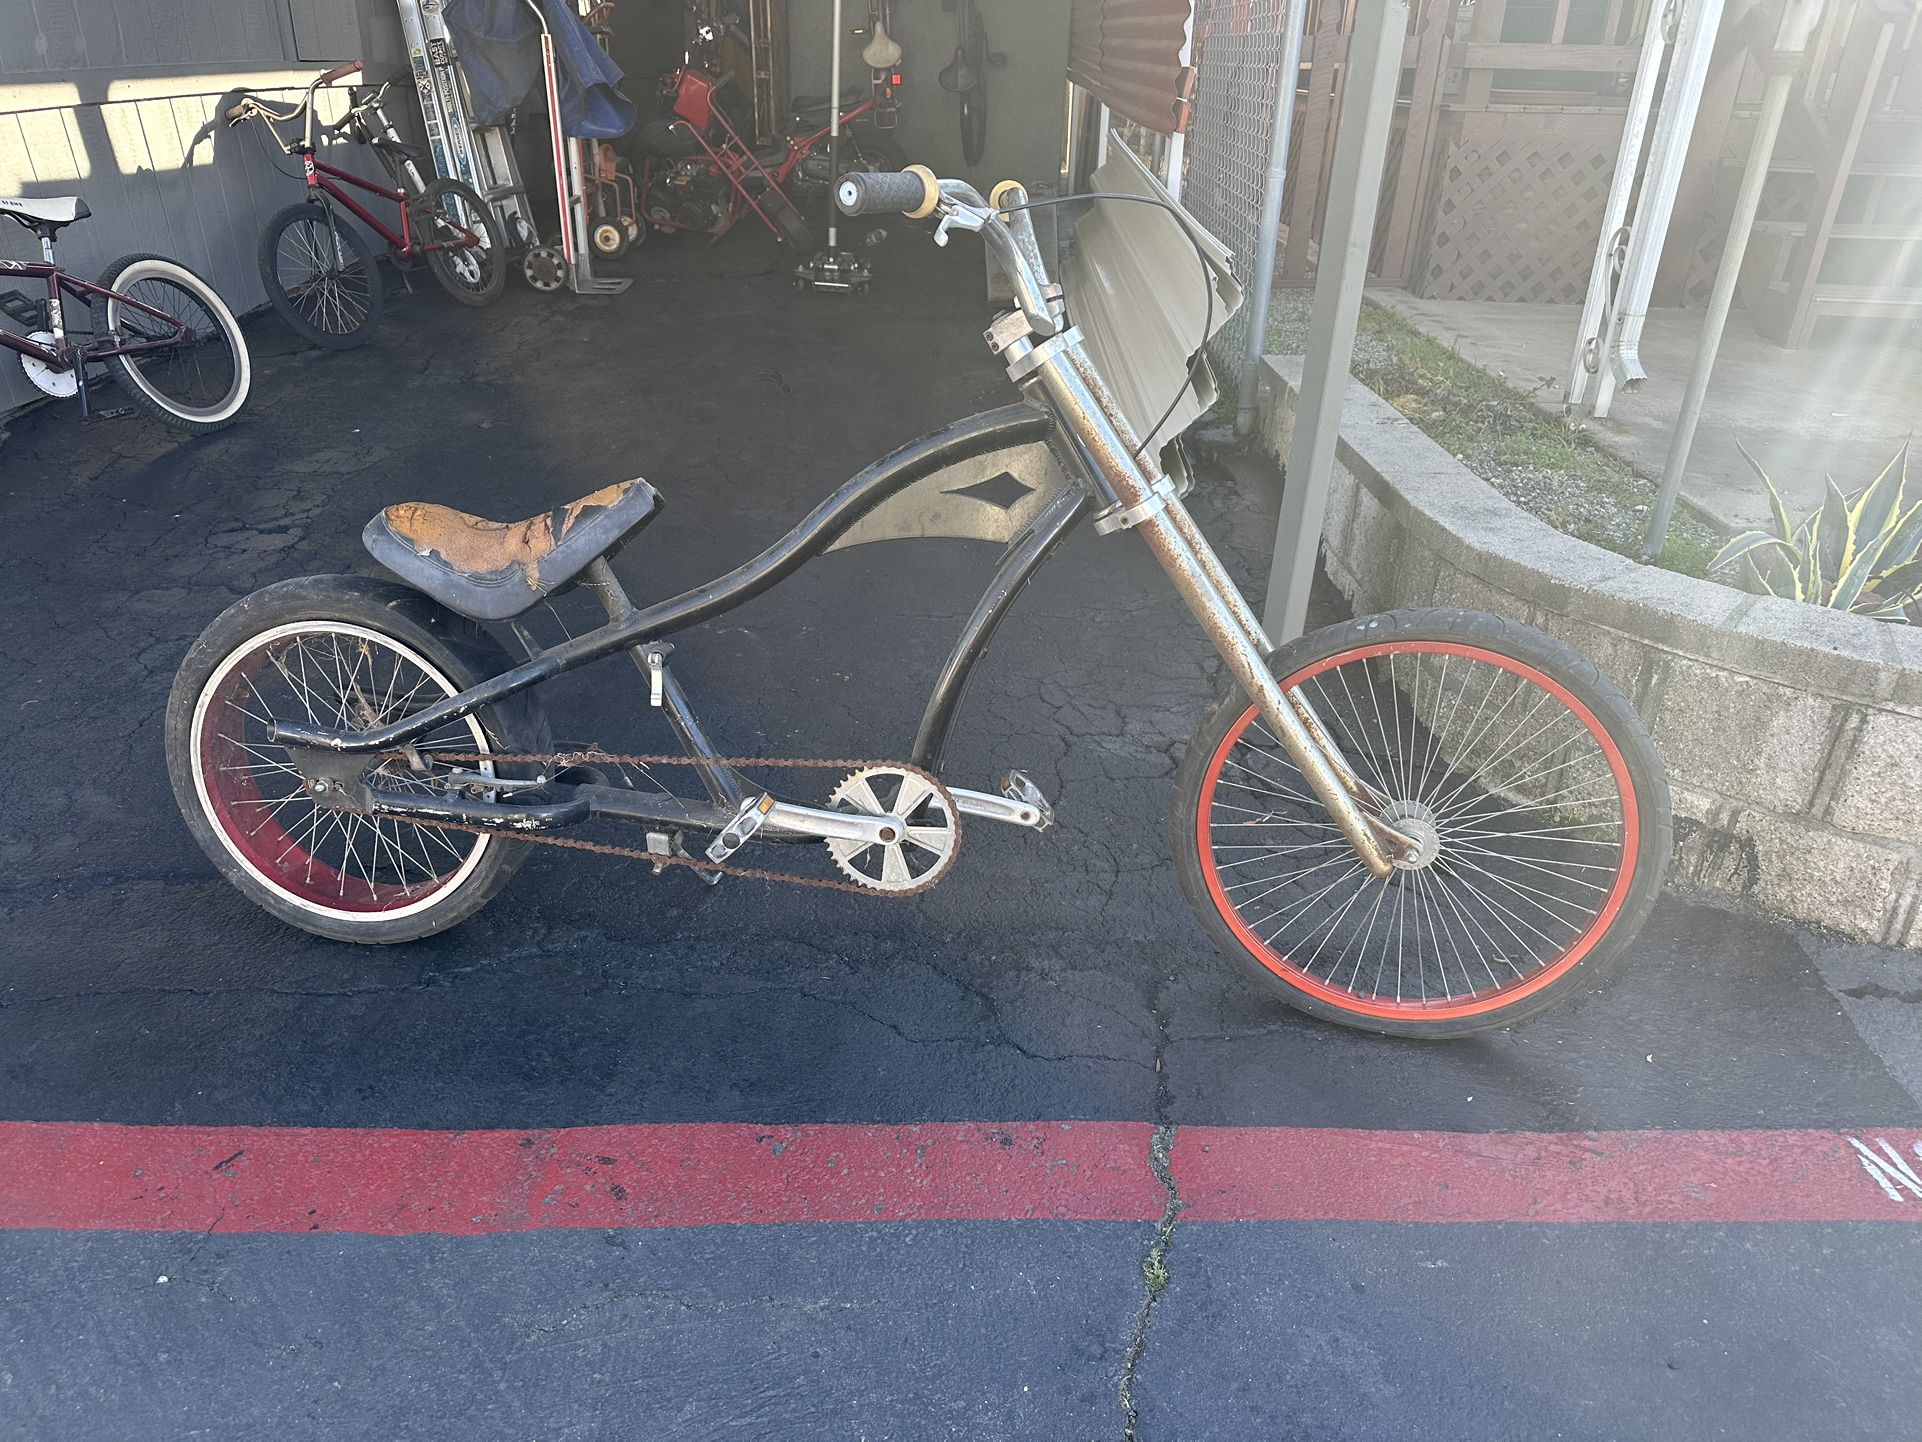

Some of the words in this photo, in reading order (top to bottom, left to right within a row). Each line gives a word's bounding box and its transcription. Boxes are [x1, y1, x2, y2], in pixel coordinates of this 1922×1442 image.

[431, 41, 441, 65] EAST
[437, 40, 447, 64] COUNTY
[454, 127, 464, 155] WERNER
